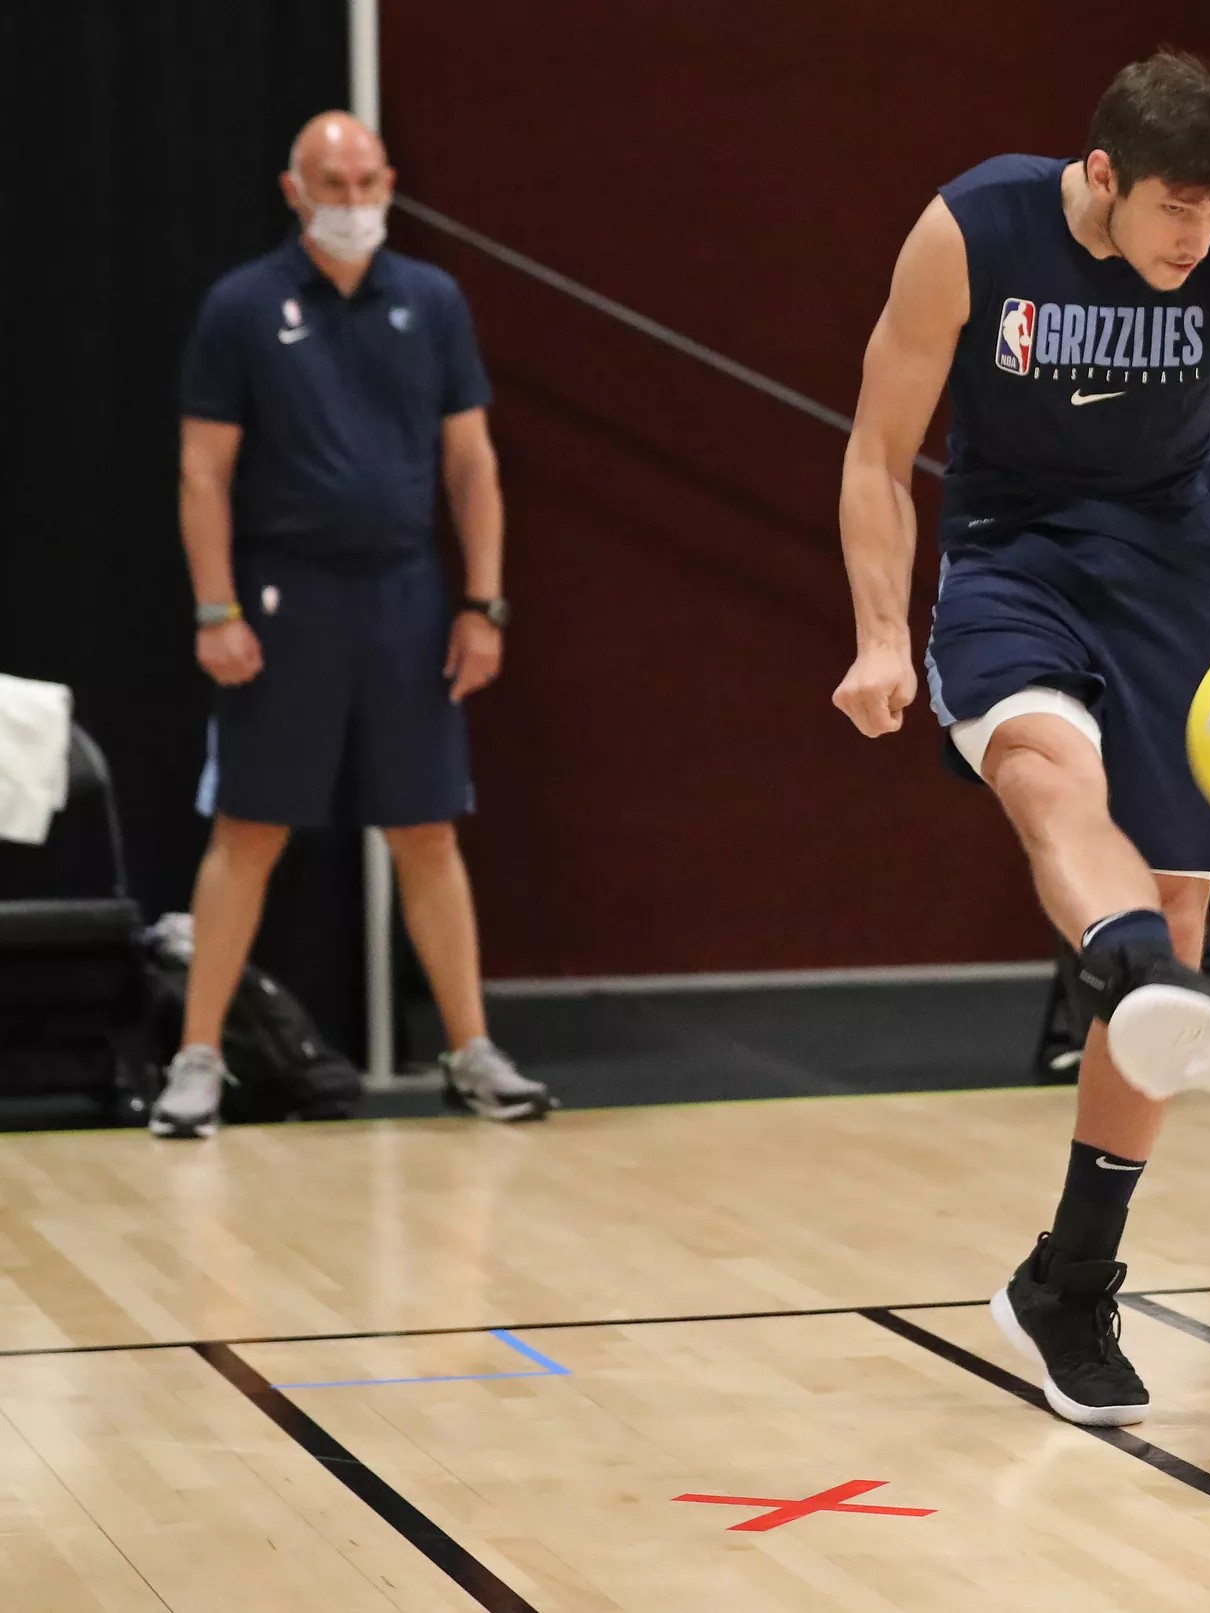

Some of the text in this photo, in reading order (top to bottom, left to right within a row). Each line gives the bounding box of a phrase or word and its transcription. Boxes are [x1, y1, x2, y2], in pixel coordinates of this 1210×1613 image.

[1036, 303, 1203, 366] GRIZZLIES
[1000, 354, 1017, 369] NBA
[1033, 367, 1199, 383] BASKETBALL
